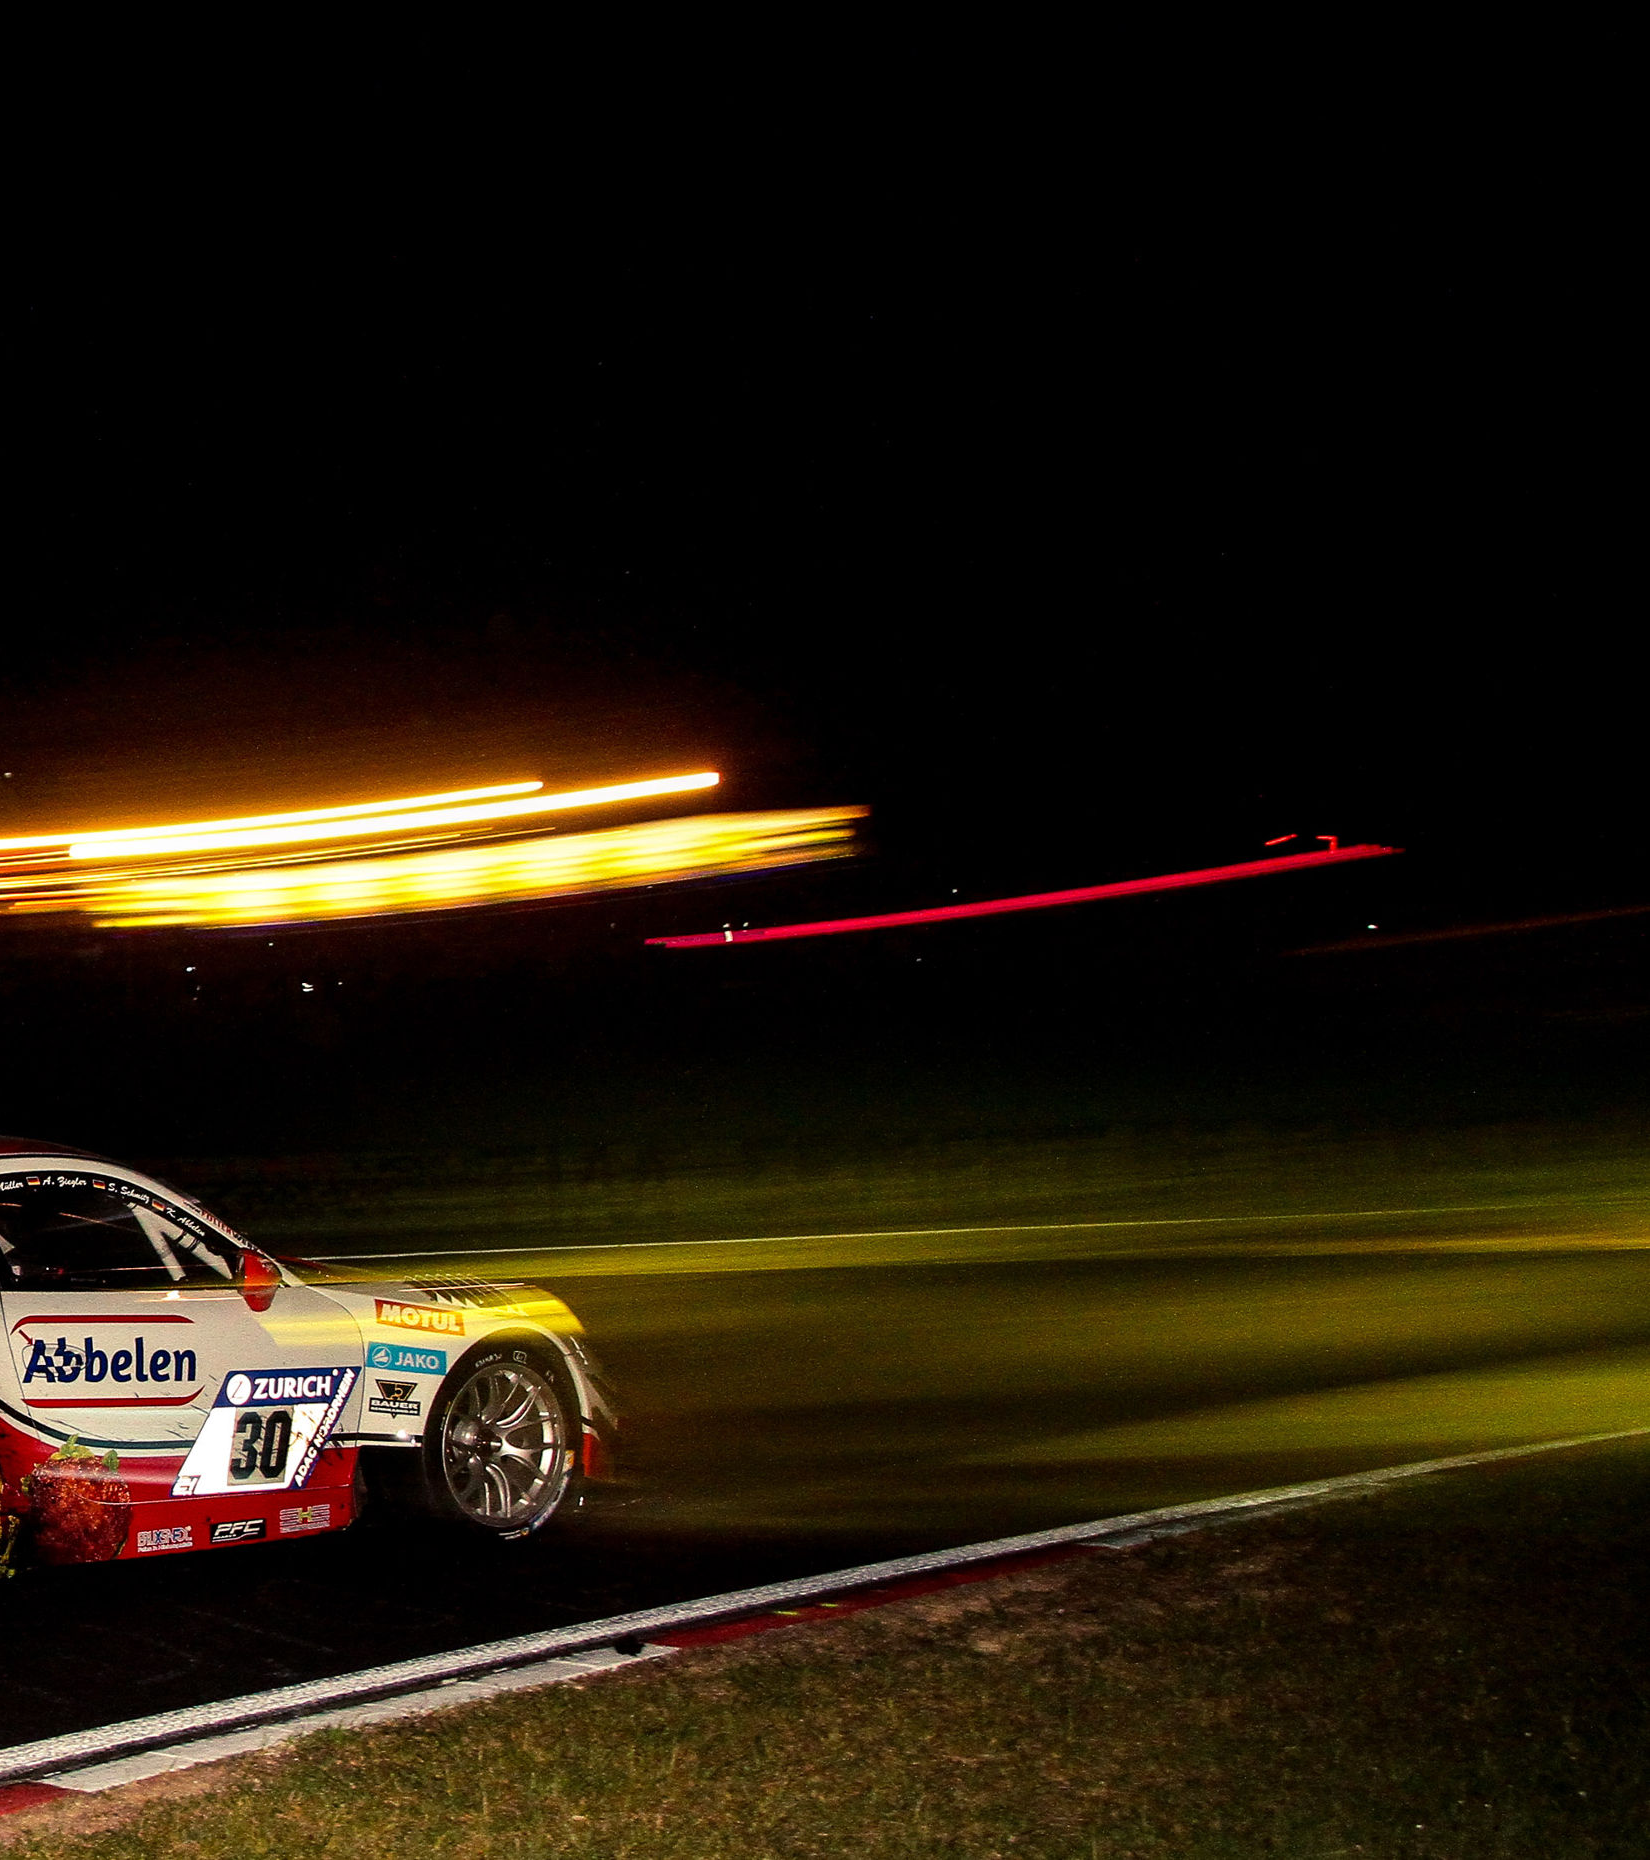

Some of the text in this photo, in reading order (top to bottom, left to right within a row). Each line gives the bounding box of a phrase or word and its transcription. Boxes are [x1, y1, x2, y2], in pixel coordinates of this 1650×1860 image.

[57, 1175, 87, 1188] Ziegler
[379, 1303, 461, 1332] MOTUL
[22, 1336, 197, 1384] Abbelen
[394, 1351, 440, 1370] JAKO
[253, 1376, 332, 1400] ZURICH
[370, 1399, 419, 1410] BAUER
[293, 1447, 319, 1488] ADAC
[314, 1367, 357, 1448] NORDRHEIN
[229, 1410, 293, 1480] 30
[213, 1519, 264, 1537] PFC
